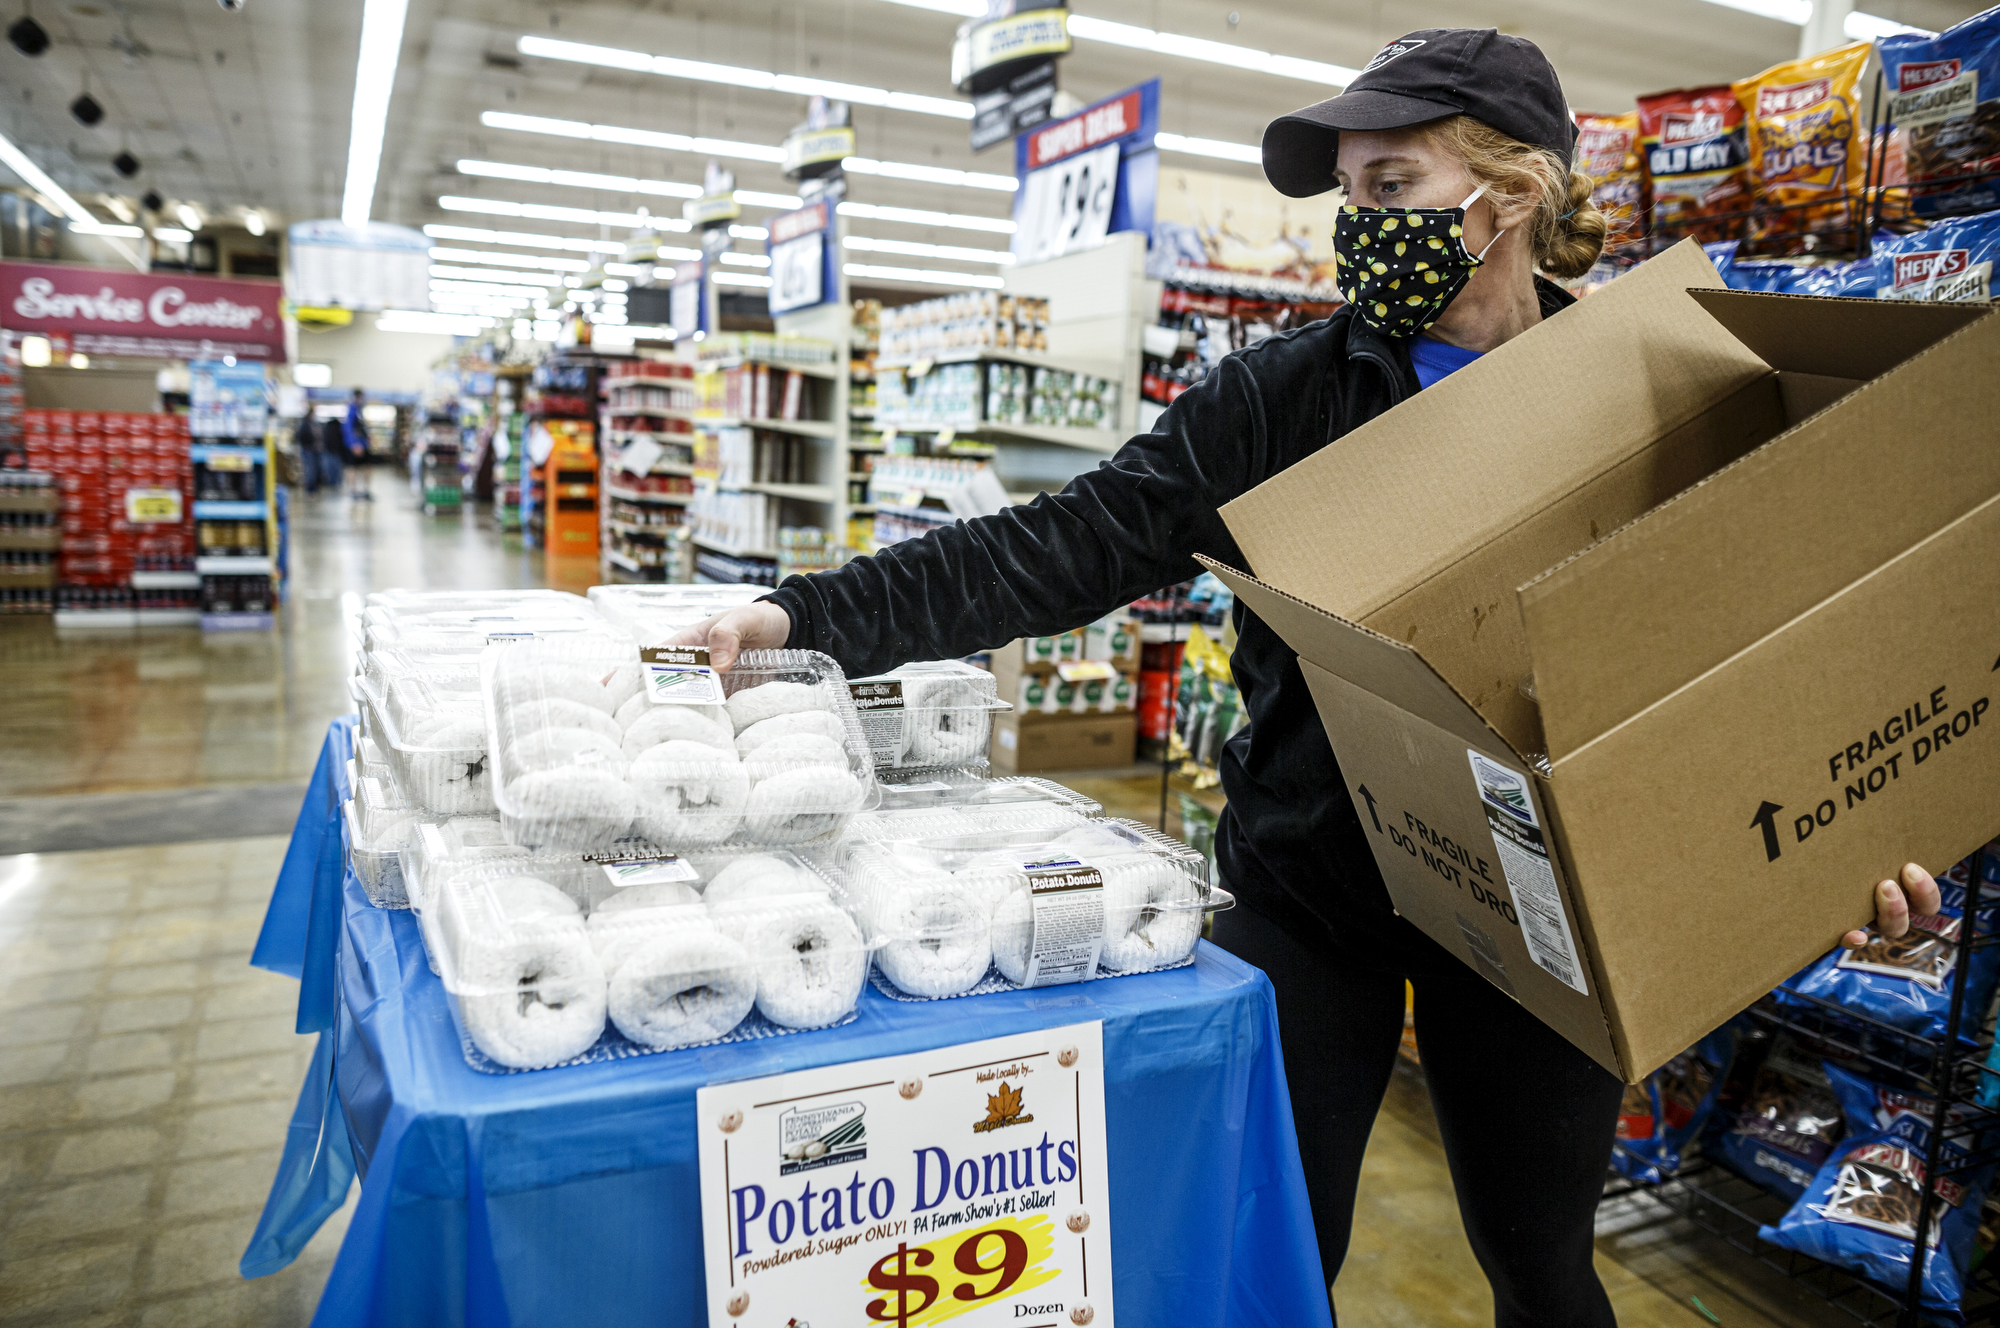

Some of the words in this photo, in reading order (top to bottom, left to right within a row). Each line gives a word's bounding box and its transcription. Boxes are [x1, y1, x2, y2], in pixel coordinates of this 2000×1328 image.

[13, 277, 145, 323] Service
[148, 286, 263, 330] Center
[874, 694, 903, 706] Donuts
[1829, 685, 1949, 783] FRAGILE
[1794, 800, 1836, 844] DO
[1845, 752, 1903, 810] NOT
[1912, 697, 1990, 766] DROP
[1403, 810, 1494, 885] FRAGILE
[1031, 876, 1065, 890] Potato
[1066, 871, 1101, 887] Donuts
[1387, 823, 1417, 858] DO
[1420, 845, 1462, 890] NOT
[1468, 878, 1519, 926] DRO
[1041, 955, 1071, 963] Nutrition
[976, 1069, 995, 1084] Made
[996, 1063, 1020, 1080] Locally
[785, 1106, 855, 1125] PENNSYLVANIA
[785, 1125, 822, 1138] POTATO
[973, 1119, 1001, 1134] Maple
[732, 1170, 895, 1259] Potato
[911, 1131, 1078, 1213] Donuts
[914, 1216, 929, 1236] PA
[931, 1208, 964, 1229] Farm
[964, 1198, 1002, 1224] Show's
[1002, 1197, 1016, 1215] #1
[1018, 1190, 1056, 1211] Seller!
[742, 1239, 815, 1278] Powdered
[817, 1232, 862, 1256] Sugar
[865, 1220, 907, 1243] ONLY!
[865, 1229, 1028, 1328] $9
[1013, 1303, 1065, 1319] Dozen
